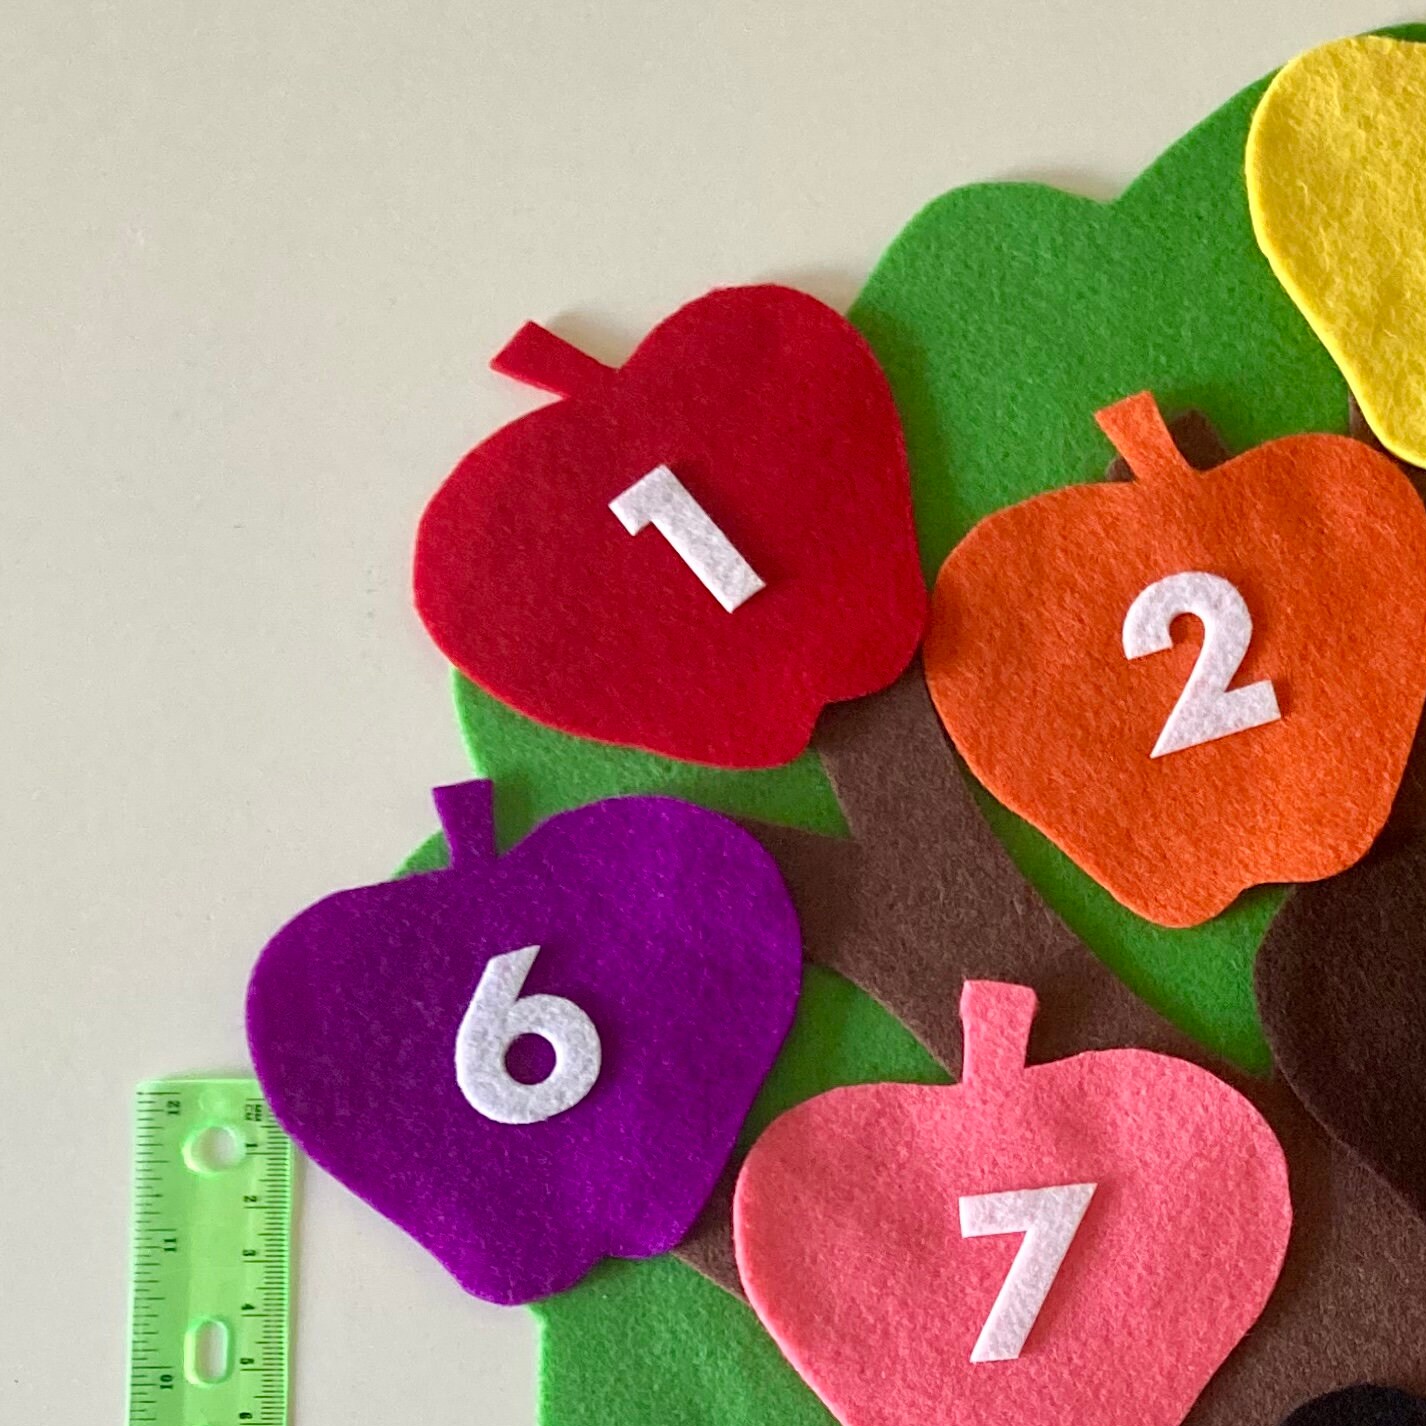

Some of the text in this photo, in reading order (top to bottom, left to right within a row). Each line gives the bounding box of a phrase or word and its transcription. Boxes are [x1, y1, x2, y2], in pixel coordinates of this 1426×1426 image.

[608, 464, 766, 613] 1
[1122, 571, 1281, 759] 2
[455, 945, 601, 1124] 6
[166, 1100, 181, 1116] 12
[243, 1195, 257, 1203] 2
[163, 1238, 177, 1252] 11
[242, 1249, 256, 1257] 3
[959, 1183, 1098, 1363] 7
[241, 1303, 255, 1311] 4
[239, 1357, 254, 1365] 5
[160, 1374, 174, 1390] 10
[238, 1411, 253, 1420] 6
